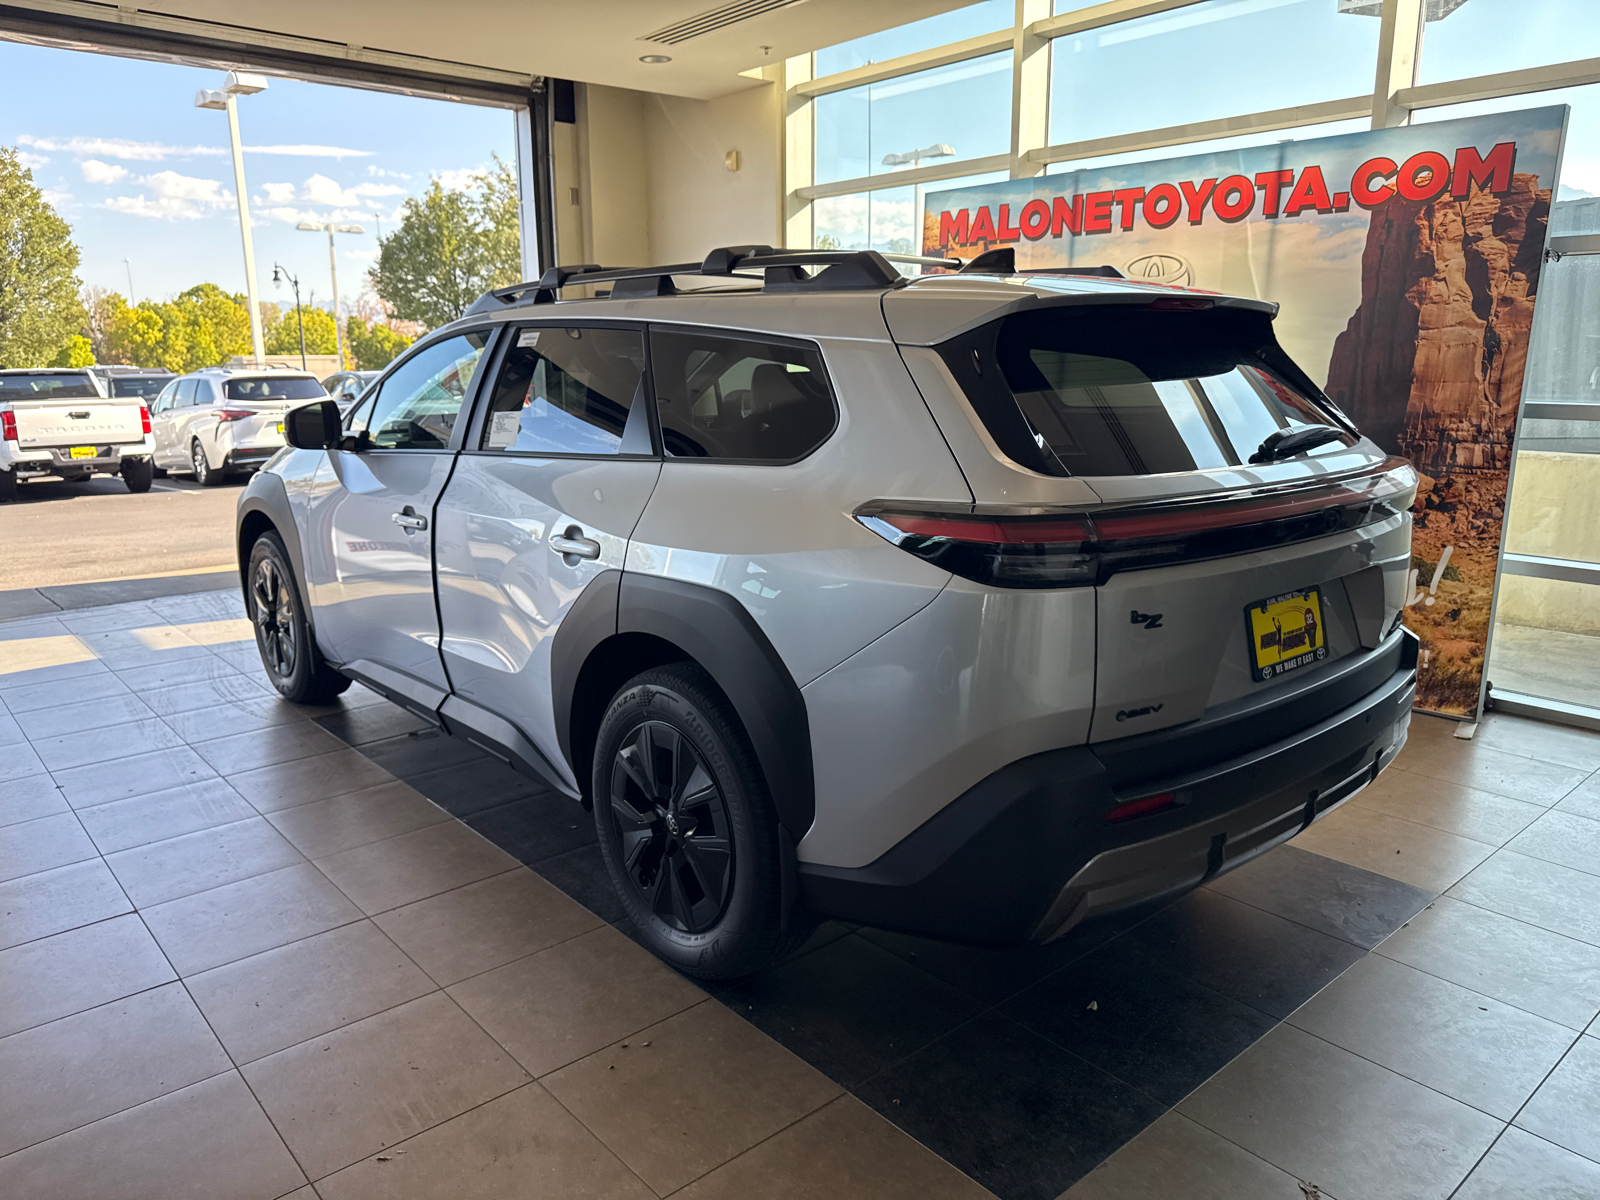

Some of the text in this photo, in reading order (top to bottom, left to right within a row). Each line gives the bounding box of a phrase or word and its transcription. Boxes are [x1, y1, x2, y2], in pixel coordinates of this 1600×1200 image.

[939, 142, 1517, 247] MALONETOYOTA.COM
[1306, 613, 1314, 624] 32
[1275, 664, 1284, 674] WE
[1284, 658, 1297, 671] MAKE
[1297, 656, 1303, 666] IT
